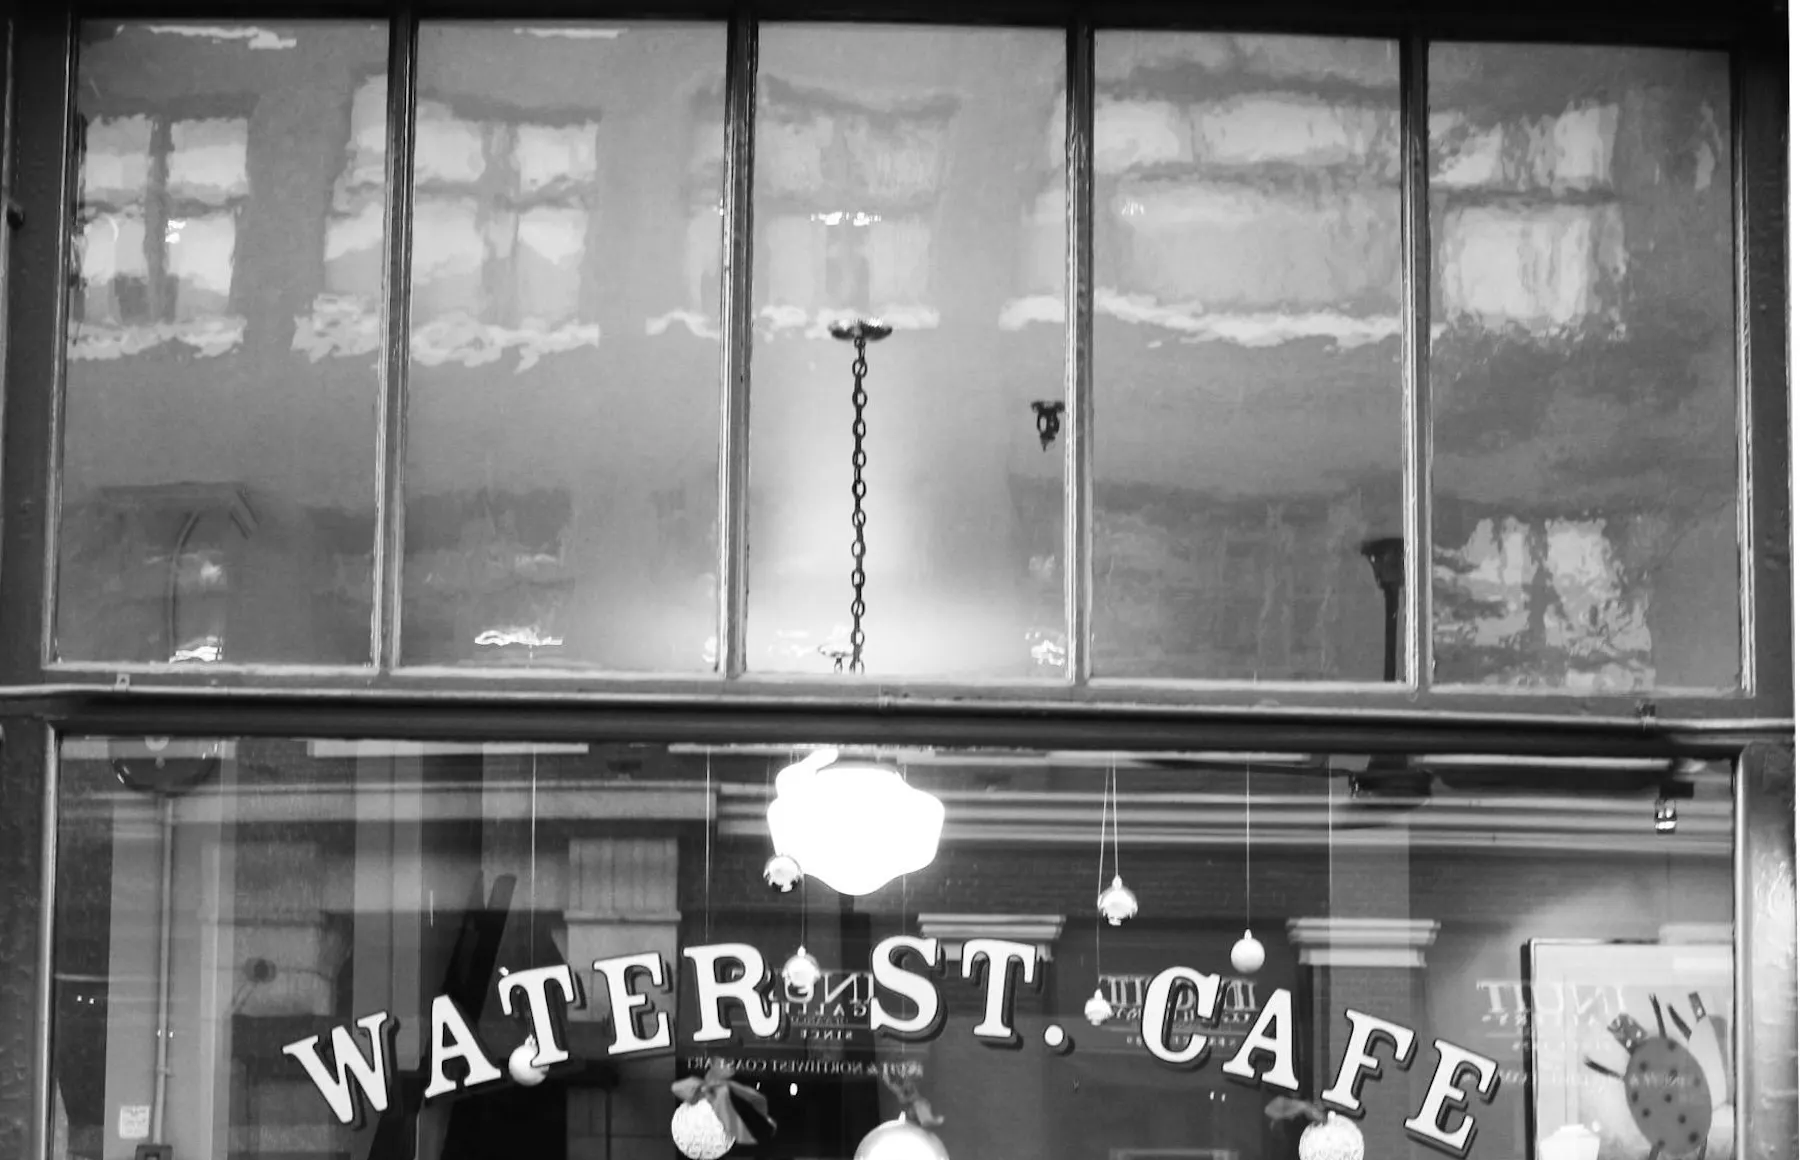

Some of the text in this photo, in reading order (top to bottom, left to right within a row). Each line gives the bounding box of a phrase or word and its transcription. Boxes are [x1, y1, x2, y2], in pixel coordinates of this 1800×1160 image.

[282, 933, 1498, 1152] WATER ST. CAFE
